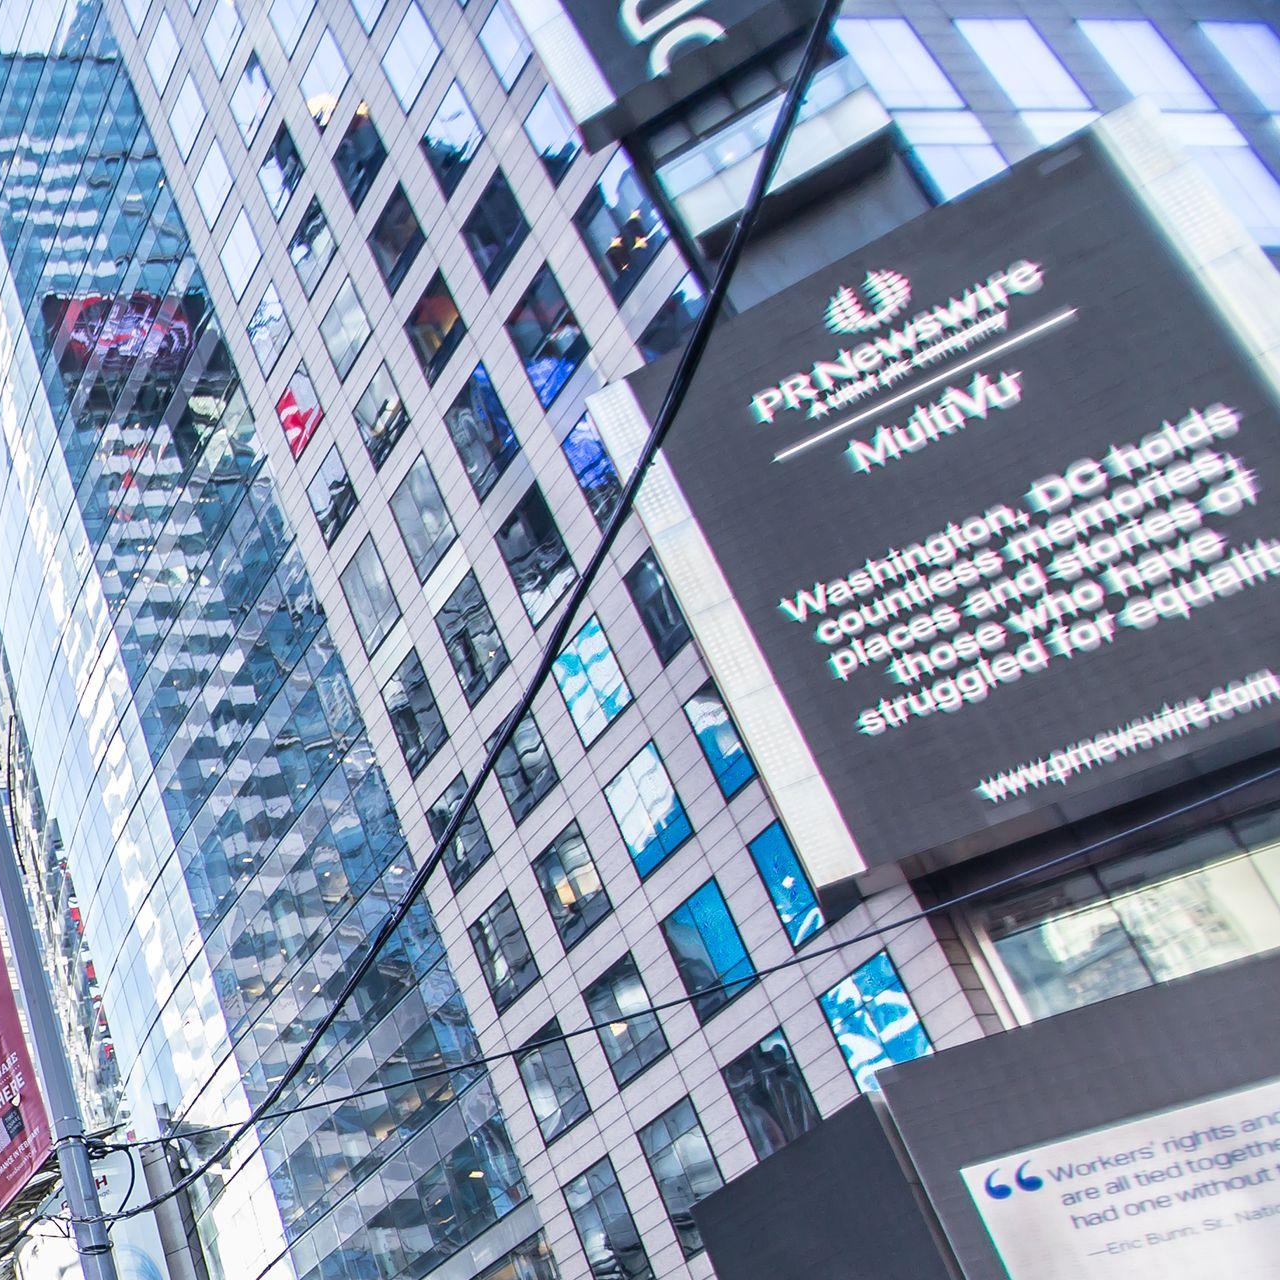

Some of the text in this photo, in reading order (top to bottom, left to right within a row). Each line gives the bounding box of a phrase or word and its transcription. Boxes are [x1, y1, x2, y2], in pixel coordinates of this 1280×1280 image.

[842, 370, 1023, 475] MultiVu
[778, 402, 1244, 624] Washington, DC holds
[816, 449, 1242, 645] countless memories,
[828, 468, 1262, 681] places and stories of
[888, 527, 1229, 686] those who have
[856, 609, 1119, 737] struggled for
[1046, 1123, 1236, 1183] Workers' rights
[1060, 1183, 1101, 1207] are
[1105, 1176, 1131, 1196] all
[1135, 1162, 1184, 1187] tied
[1070, 1166, 1274, 1230] had one without
